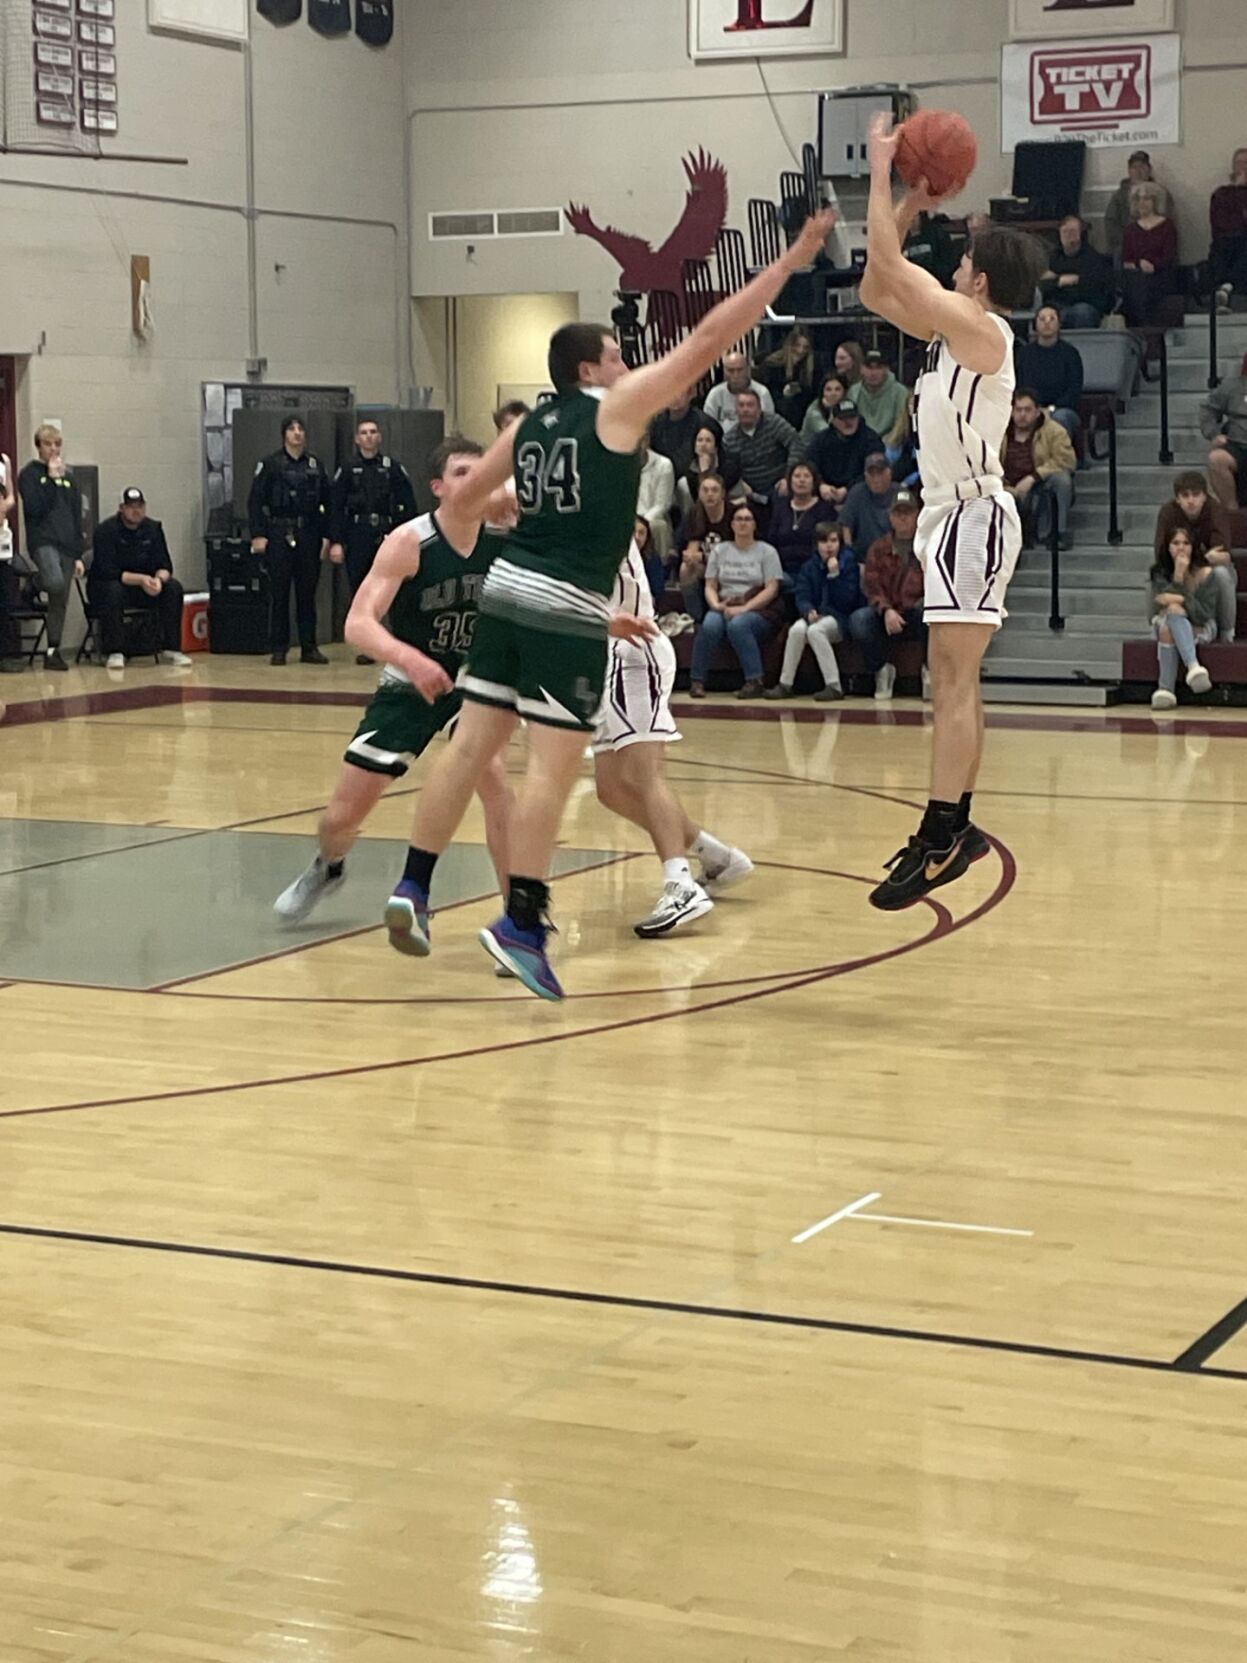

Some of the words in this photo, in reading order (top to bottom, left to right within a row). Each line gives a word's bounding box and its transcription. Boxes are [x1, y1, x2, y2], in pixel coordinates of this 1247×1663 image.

[1045, 63, 1135, 83] TICKET
[1053, 80, 1124, 110] TV
[518, 437, 580, 514] 34
